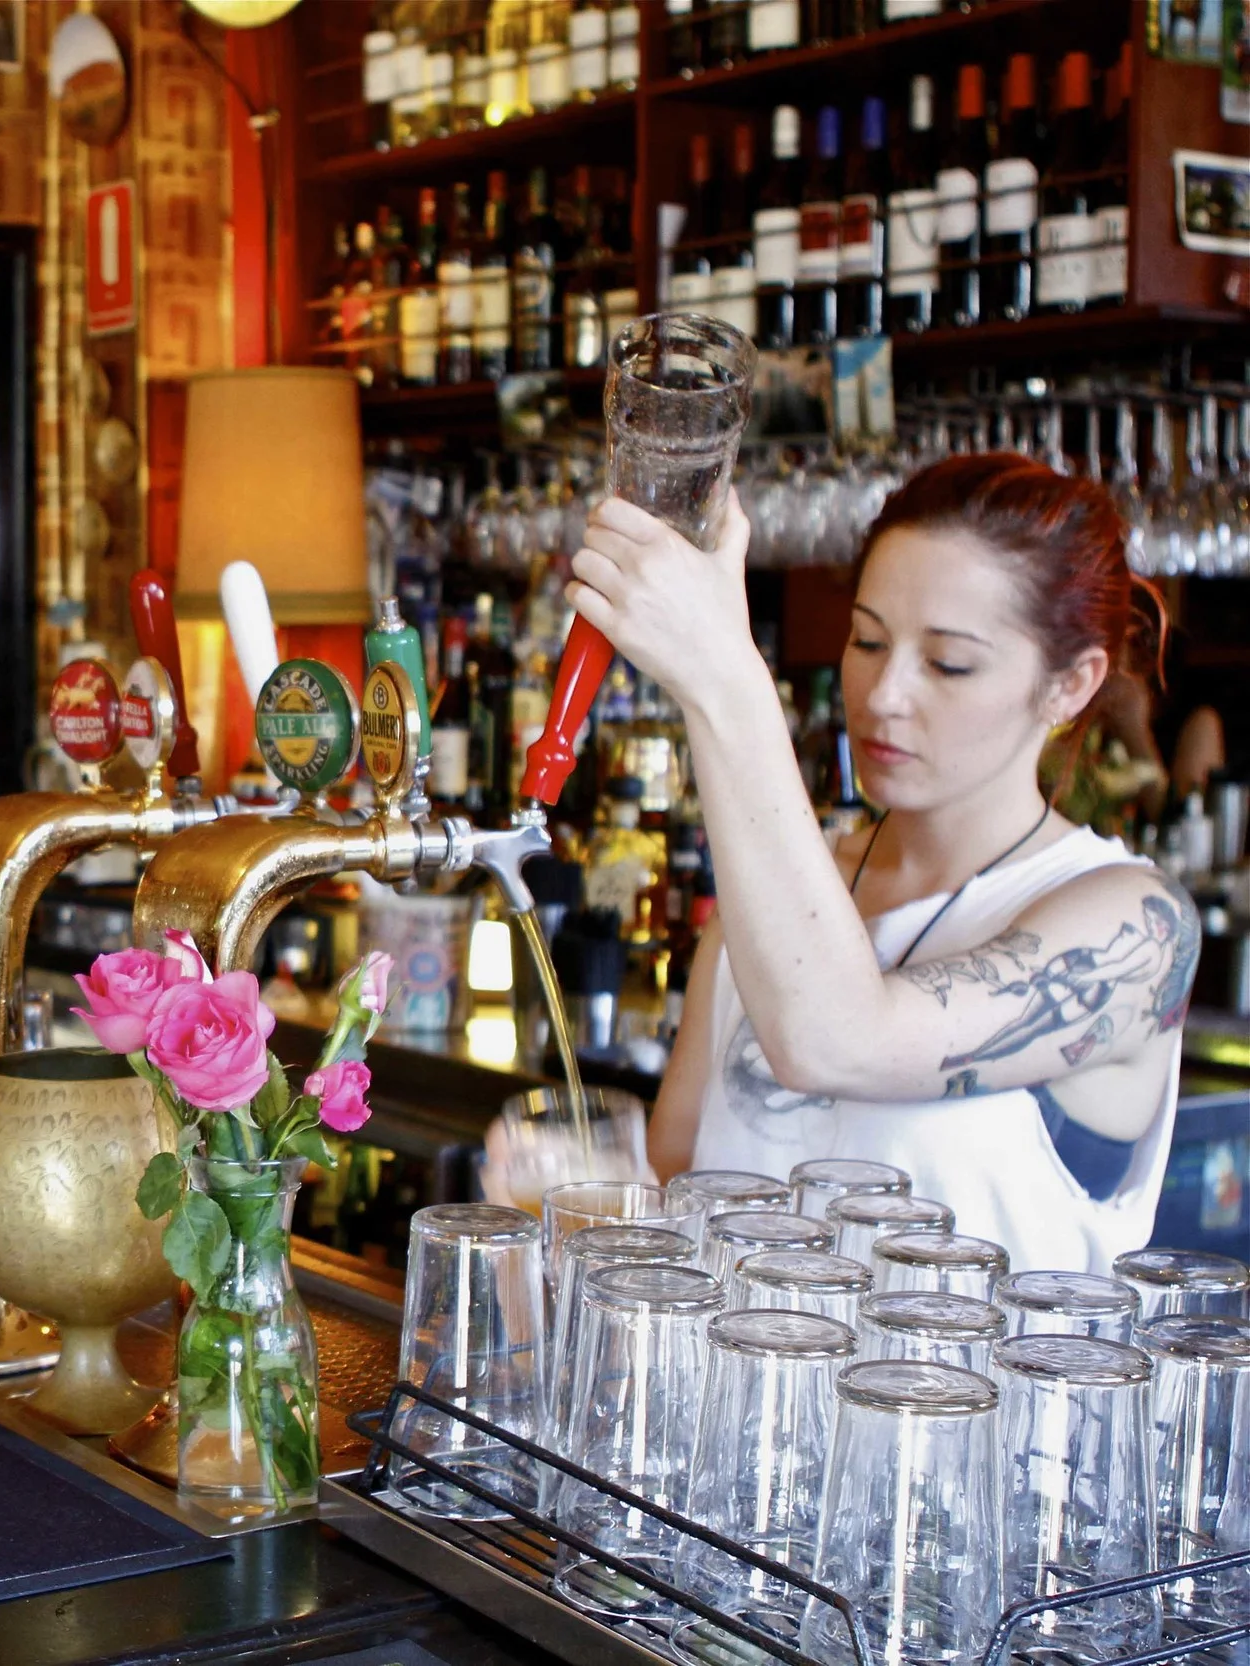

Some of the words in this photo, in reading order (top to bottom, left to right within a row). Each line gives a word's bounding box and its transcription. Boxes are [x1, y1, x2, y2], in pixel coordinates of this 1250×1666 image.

[263, 671, 327, 711] CASCADE
[55, 715, 105, 730] CARLTON
[261, 716, 297, 736] PALE
